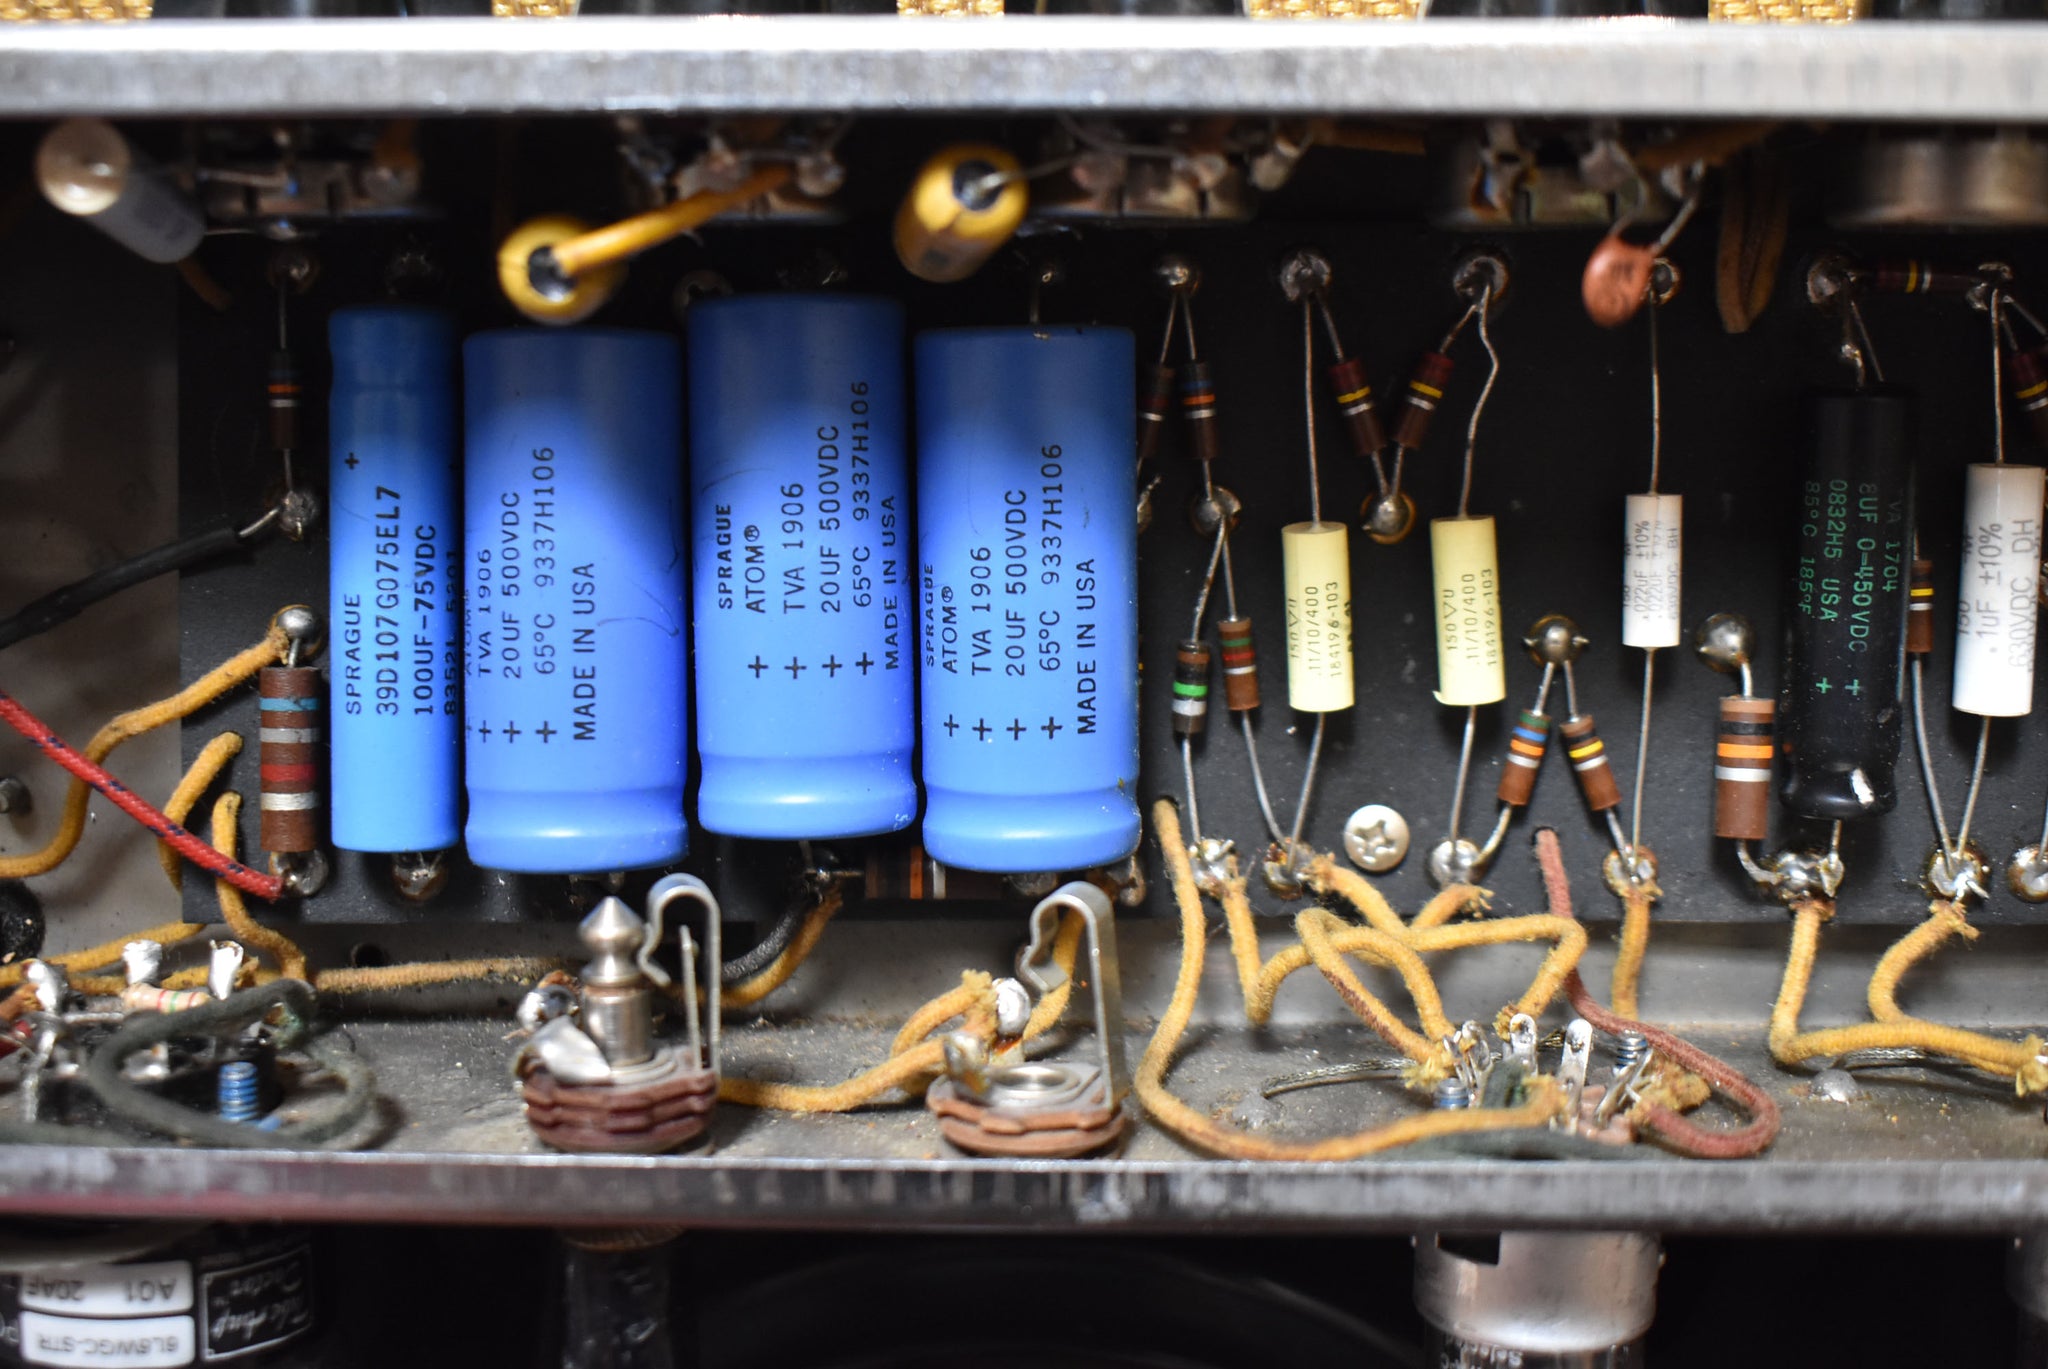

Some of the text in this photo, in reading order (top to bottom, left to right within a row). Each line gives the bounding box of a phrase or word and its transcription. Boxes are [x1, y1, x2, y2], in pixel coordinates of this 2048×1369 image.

[532, 445, 556, 588] 9337H106
[817, 425, 841, 614] 20UF 500VDC
[851, 381, 870, 521] 9337H106
[1040, 443, 1063, 585] 9337H106
[374, 485, 400, 717] 39D107G075EL7
[477, 548, 492, 677] TVA 1906
[500, 491, 522, 680] 20UF 500VDC
[715, 503, 732, 610] SPRAGUE
[780, 482, 805, 614] TVA 1906
[881, 495, 899, 670] MADE IN USA
[923, 563, 936, 668] SPRAGUE
[970, 546, 991, 676] TVA 1906
[1004, 489, 1027, 677] 20UF 500VDC
[1819, 578, 1840, 621] USA
[1881, 539, 1901, 593] 1704
[343, 593, 362, 716] SPRAGUE
[413, 524, 436, 716] 100UF-75VDC
[572, 562, 596, 741] MADE IN USA
[1076, 558, 1097, 735] MADE IN USA
